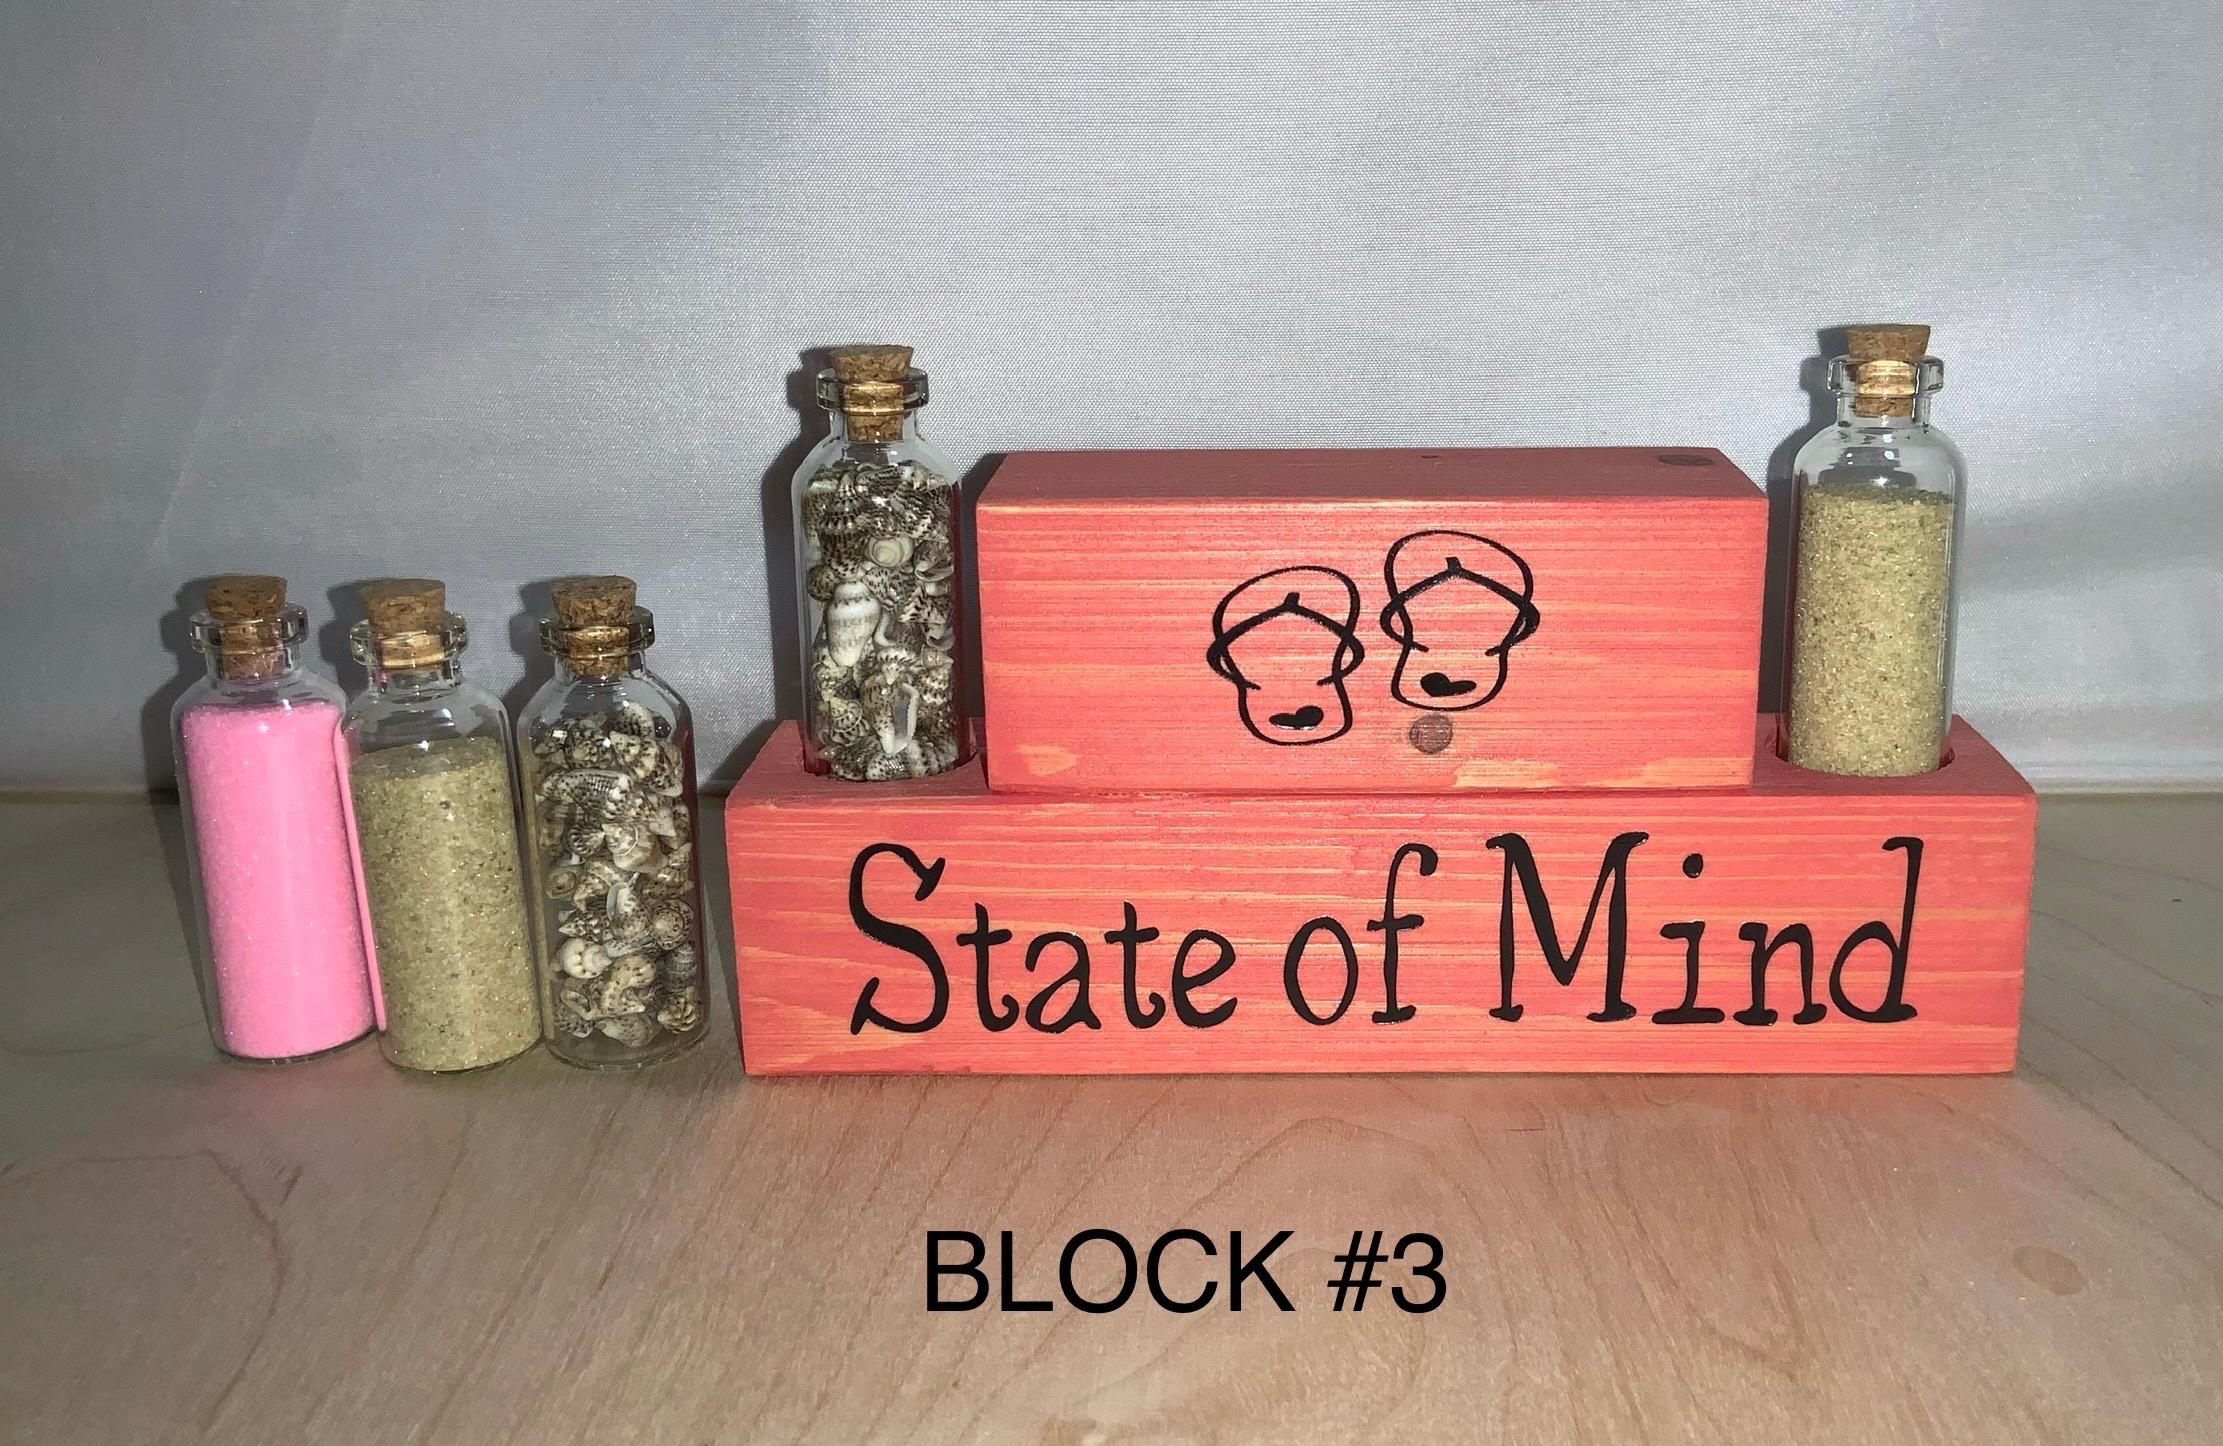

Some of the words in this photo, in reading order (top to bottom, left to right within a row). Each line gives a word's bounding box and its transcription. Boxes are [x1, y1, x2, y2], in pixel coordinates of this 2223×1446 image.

[849, 843, 1237, 1035] State
[1284, 844, 1438, 1025] of
[1486, 832, 1923, 1026] Mind
